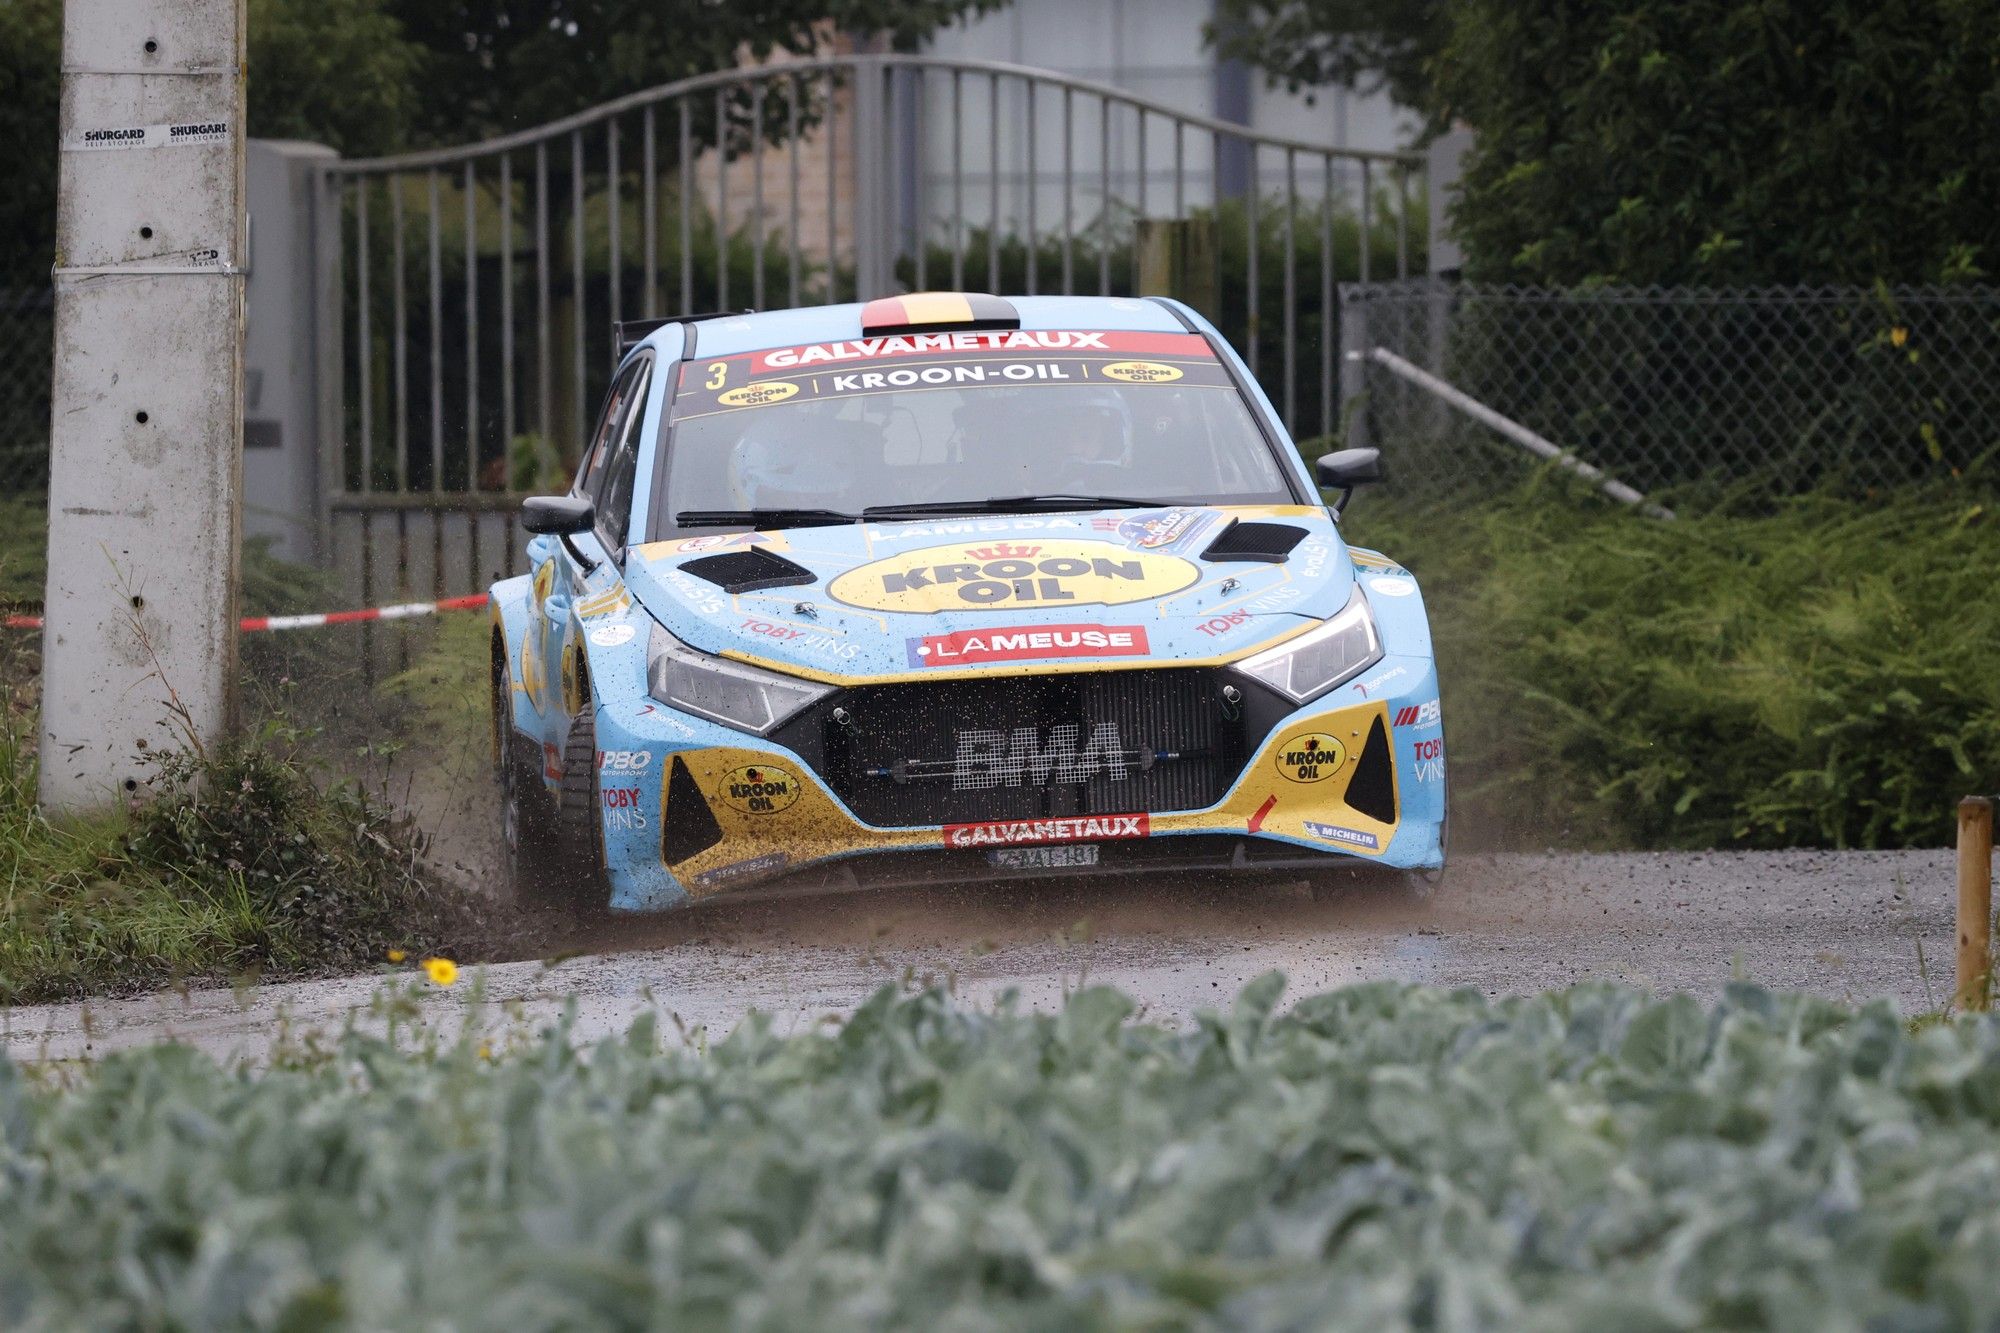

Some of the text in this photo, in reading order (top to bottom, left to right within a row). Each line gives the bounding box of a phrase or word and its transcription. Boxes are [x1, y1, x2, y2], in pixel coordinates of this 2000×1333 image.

[85, 129, 145, 141] SHURGARD
[193, 134, 226, 142] STORAG
[764, 331, 1110, 367] GALVAMETAUX
[705, 362, 728, 390] 3
[833, 363, 1070, 391] KROON-OIL
[1113, 367, 1172, 376] KROON
[729, 386, 788, 401] KROON
[746, 395, 773, 404] OIL
[882, 557, 1145, 594] KROON
[958, 578, 1075, 603] OIL
[1196, 607, 1252, 637] TOBY
[1252, 586, 1300, 611] VINS
[740, 619, 807, 640] TOBY
[806, 634, 861, 659] VINS
[602, 751, 652, 769] PBO
[1286, 750, 1336, 766] KROON
[1298, 765, 1319, 779] OIL
[602, 788, 641, 808] TOBY
[730, 781, 788, 798] KROON
[749, 797, 775, 811] OIL
[603, 809, 647, 831] VINS
[951, 817, 1141, 847] GALVAMETAUX
[1322, 827, 1374, 845] MICHELIN
